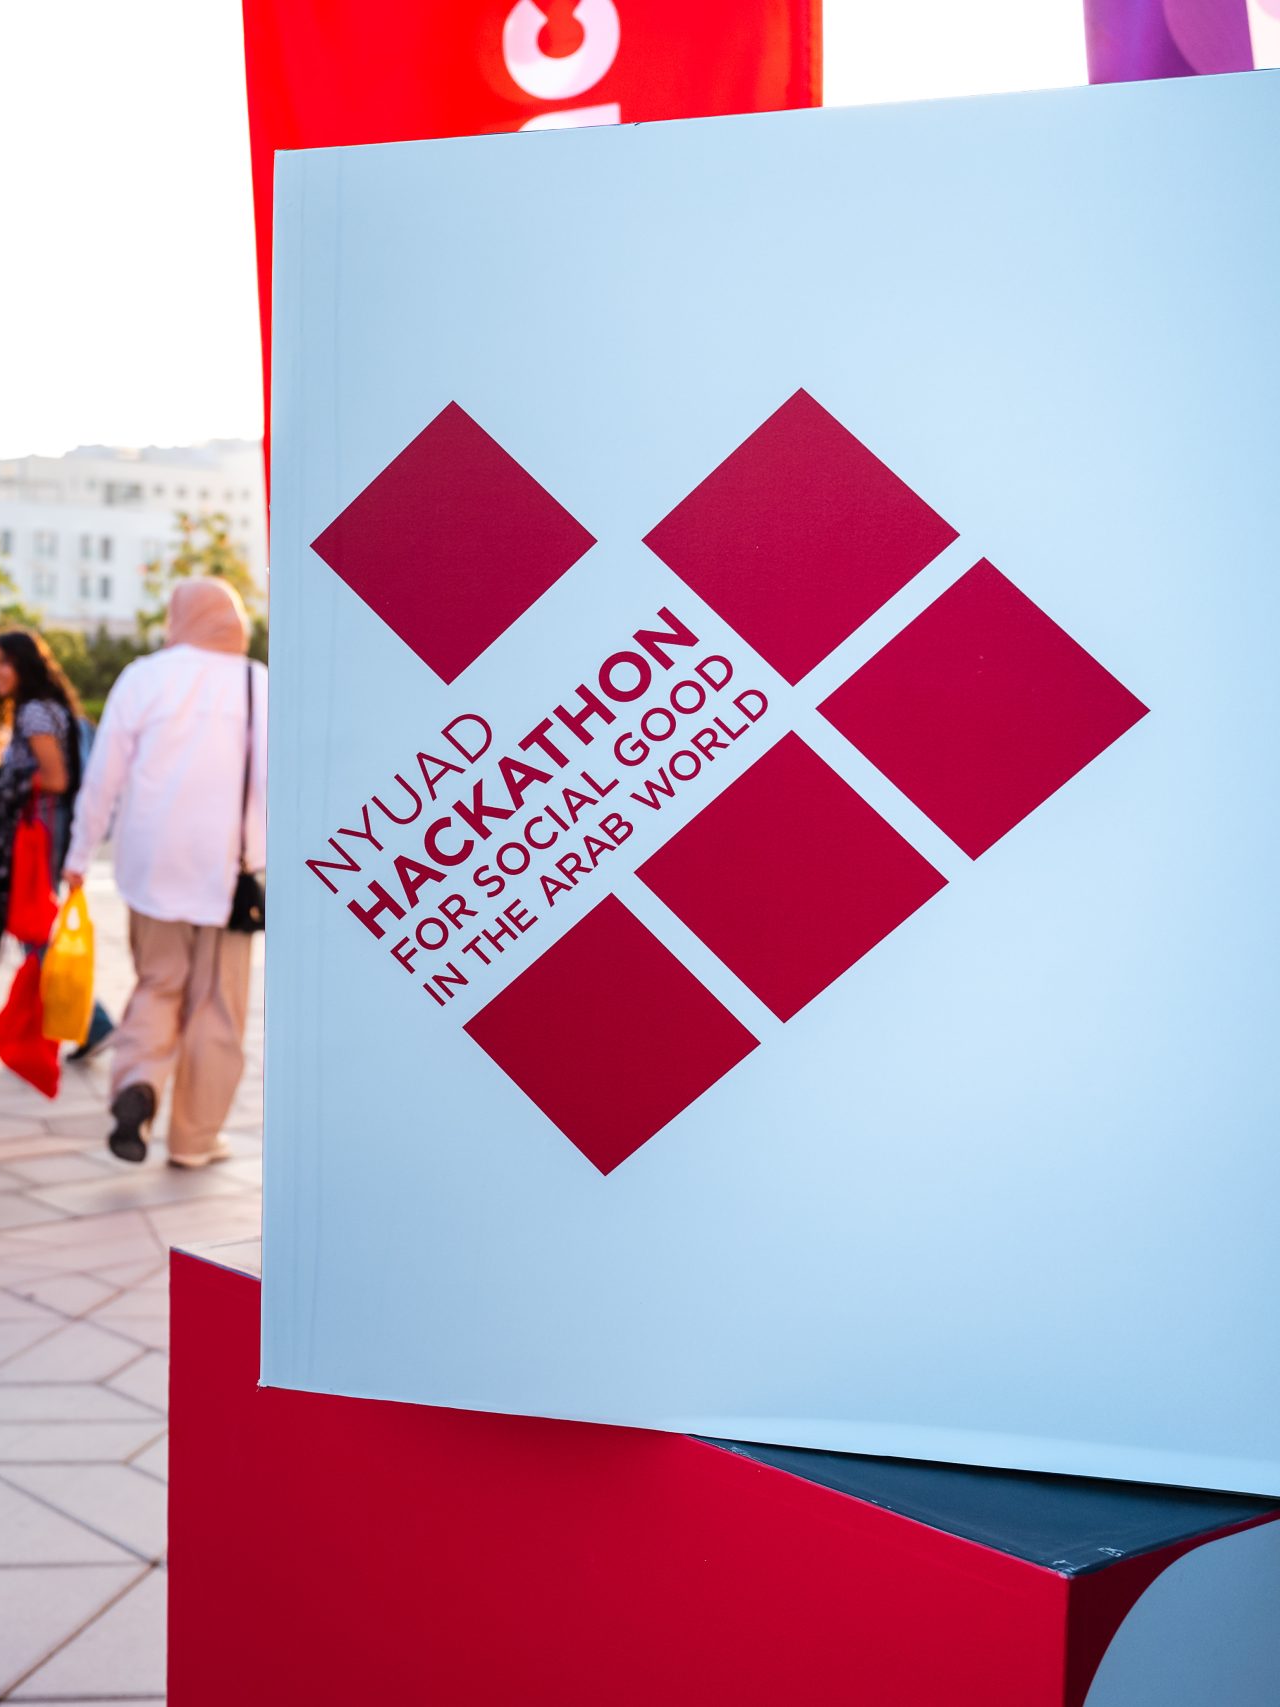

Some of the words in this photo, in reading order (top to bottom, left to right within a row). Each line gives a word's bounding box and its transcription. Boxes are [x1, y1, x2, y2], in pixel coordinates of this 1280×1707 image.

[304, 713, 493, 895] NYUAD
[346, 606, 700, 941] HACKATHON
[389, 893, 479, 975] FOR
[472, 770, 620, 899] SOCIAL
[613, 654, 734, 767] GOOD
[422, 961, 470, 1007] IN
[461, 898, 539, 966] THE
[539, 812, 634, 908] ARAB
[629, 689, 769, 811] WORLD
